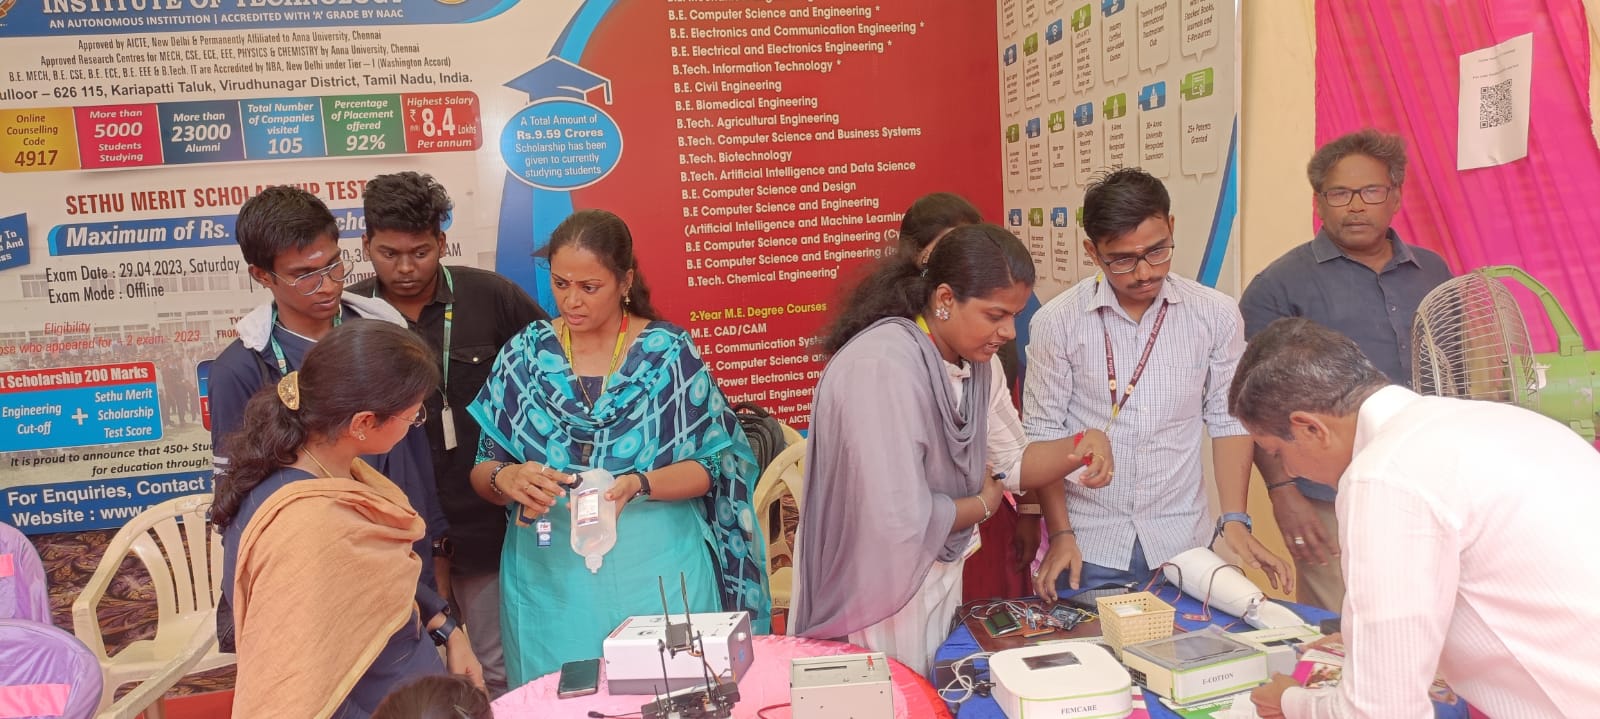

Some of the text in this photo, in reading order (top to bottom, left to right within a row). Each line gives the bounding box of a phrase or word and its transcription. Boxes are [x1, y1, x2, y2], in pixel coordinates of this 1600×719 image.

[50, 20, 64, 28] AN
[67, 18, 144, 27] AUTONOMOUS
[146, 15, 210, 25] INSTITUTION
[221, 12, 282, 22] ACCREDITED
[284, 12, 309, 20] WITH
[326, 10, 359, 19] GRADE
[362, 10, 374, 18] BY
[377, 9, 403, 18] NAAC
[78, 40, 113, 50] Approved
[116, 39, 124, 49] by
[127, 38, 149, 48] AICTE,
[152, 37, 168, 47] New
[170, 36, 190, 46] Delhi
[200, 34, 245, 45] Permanently
[247, 33, 280, 43] Affiliated
[283, 33, 289, 42] to
[292, 33, 310, 41] Anna
[352, 30, 381, 40] Chennai
[54, 73, 472, 98] 626 115, Kariapatti Taluk, Virudhunagar District, Tamil Nadu, India.
[247, 103, 313, 113] Total Number
[334, 100, 388, 110] Percentage
[407, 96, 473, 107] Highest Salary
[675, 96, 818, 111] B.E. Biomedical Engineering
[17, 114, 45, 123] Online
[90, 109, 142, 119] More than
[173, 112, 225, 122] More than
[248, 114, 314, 125] of Companies
[331, 110, 393, 120] of Placement
[521, 114, 597, 126] A Total Amount of
[677, 113, 839, 129] B.Tech. Agricultural Engineering
[267, 125, 299, 134] visited
[346, 121, 381, 132] offered
[422, 108, 476, 137] 8.4 Lakhs
[7, 125, 58, 136] Counselling
[94, 122, 142, 138] 5000
[171, 124, 231, 142] 23000
[517, 129, 603, 140] Rs.9.59 Crores
[678, 127, 921, 147] B.Tech. Computer Science and Business Systems
[23, 138, 45, 146] Code
[99, 141, 142, 151] Students
[185, 143, 220, 153] Alumni
[268, 138, 302, 155] 105
[346, 134, 386, 151] 92%
[417, 139, 472, 149] Per annum
[515, 141, 606, 152] Scholarship has been
[15, 150, 58, 167] 4917
[100, 152, 143, 163] Studying
[525, 156, 548, 167] given
[562, 153, 599, 163] currently
[680, 150, 792, 164] B.Tech. Biotechnology
[526, 166, 601, 178] studying students
[681, 160, 916, 182] B.Tech. Artificial Intelligence and Data Science
[66, 180, 366, 215] SETHU MERIT TEST
[682, 181, 856, 200] B.E. Computer Science and Design
[4, 230, 17, 238] To
[66, 220, 230, 247] Maximum of Rs.
[6, 239, 24, 248] And
[46, 256, 239, 282] Exam Date 29.04.2023, Saturday
[48, 284, 164, 304] Exam Mode Offline
[690, 302, 827, 321] 2-Year M.E. Degree Courses
[44, 322, 91, 335] Eligibility
[691, 323, 767, 338] M.E. CAD/CAM
[7, 366, 148, 389] Scholarship 200 Marks
[95, 388, 152, 402] Sethu Merit
[2, 404, 154, 420] Engineering Scholarship
[17, 422, 152, 438] Cut-off Test Score
[11, 444, 189, 467] It is proud to announce that 450+
[92, 458, 209, 476] for education through
[8, 476, 204, 506] For Enquiries, Contact
[13, 511, 84, 526] Website
[1202, 673, 1234, 685] E-COTTON
[1061, 704, 1097, 715] FEMCARE
